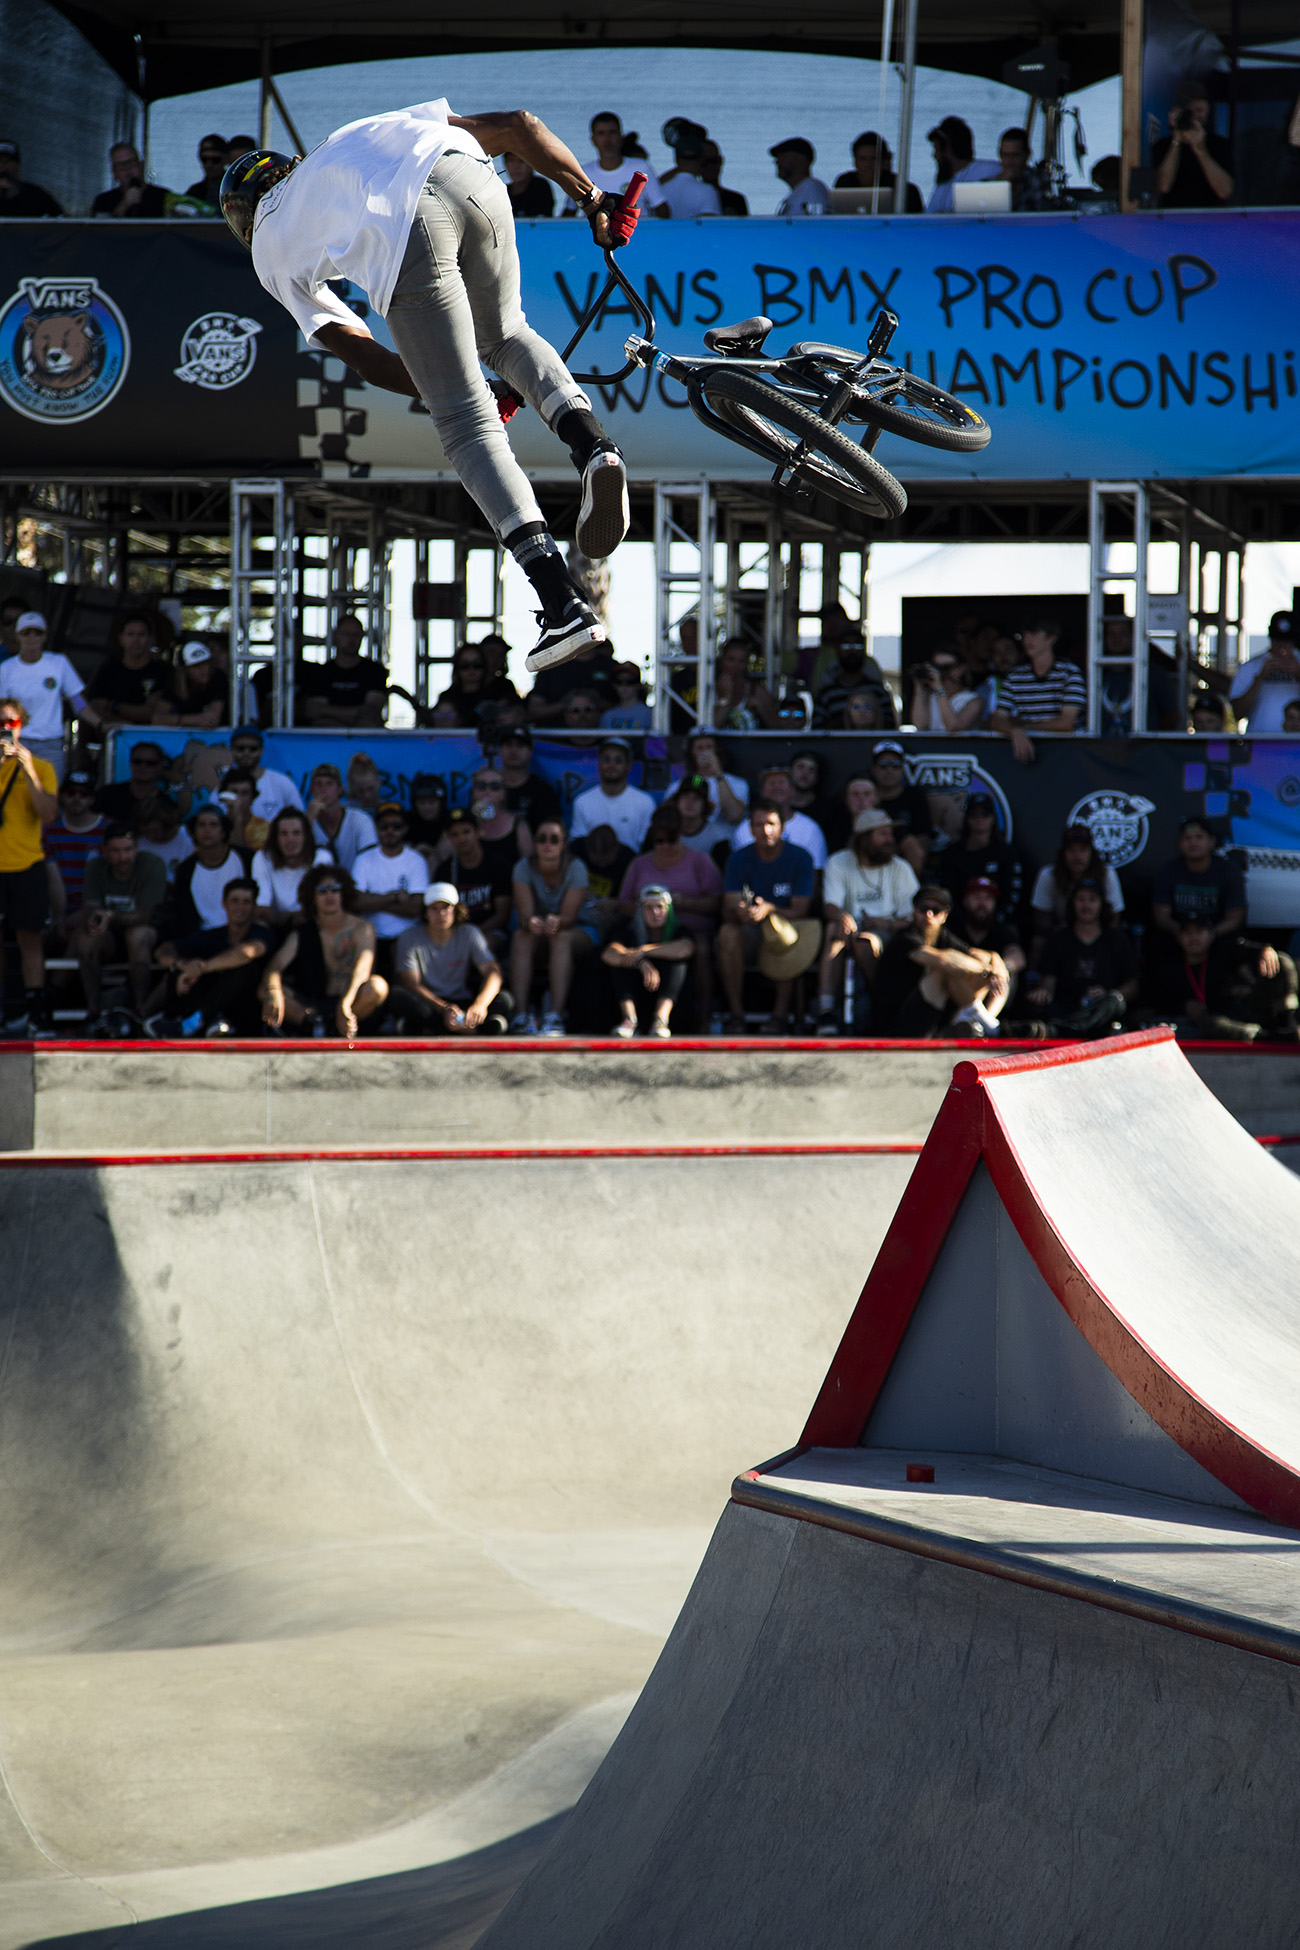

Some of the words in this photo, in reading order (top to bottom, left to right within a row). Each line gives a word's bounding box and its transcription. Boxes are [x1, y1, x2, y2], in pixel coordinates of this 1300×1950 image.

[26, 284, 92, 309] VANS
[555, 270, 723, 331] VANS
[754, 263, 901, 327] BMX
[934, 264, 1063, 329] PRO
[1086, 254, 1218, 323] CUP
[186, 338, 247, 362] VANS
[903, 762, 970, 787] VANS
